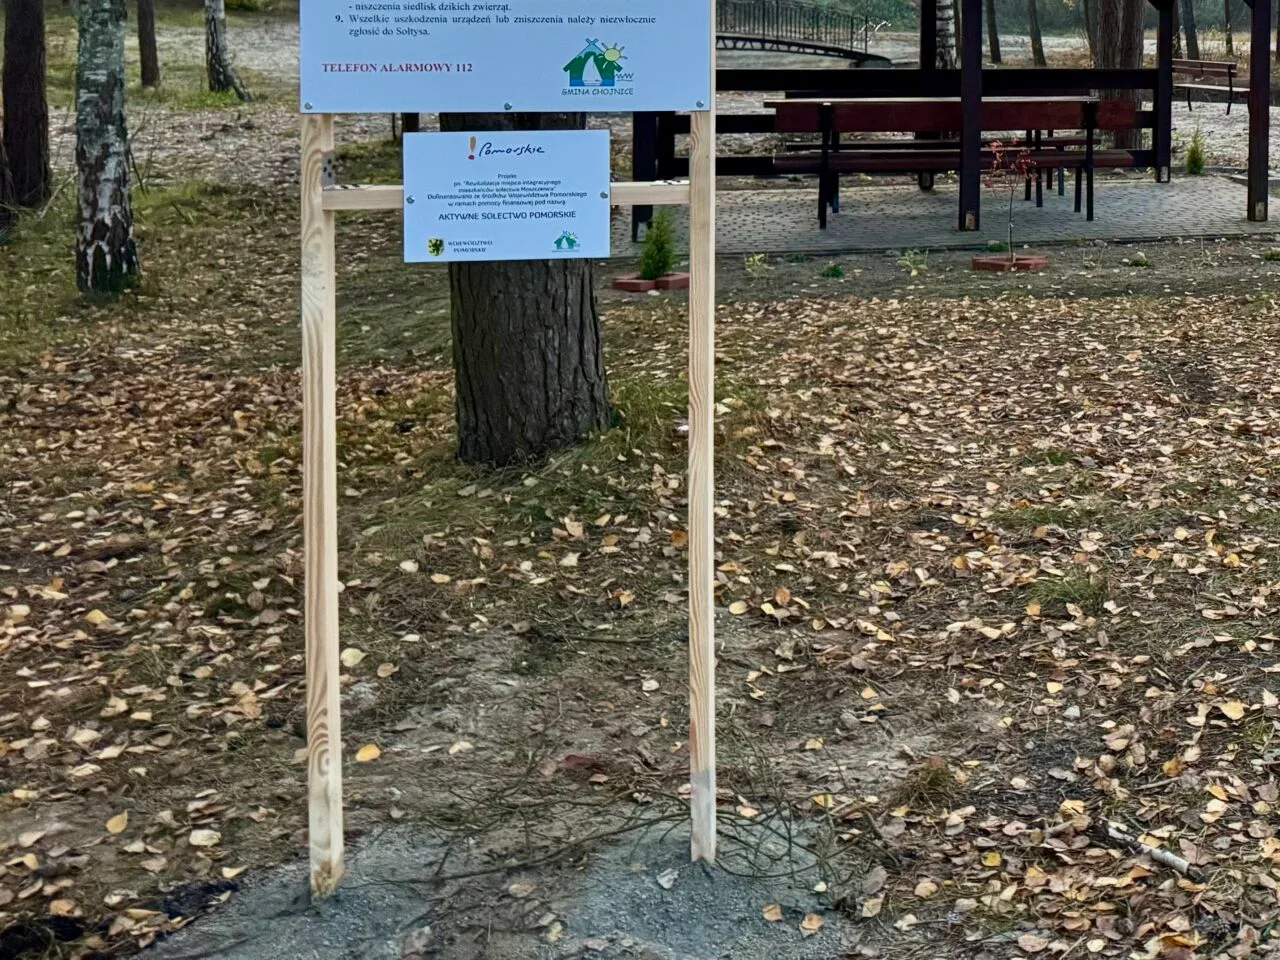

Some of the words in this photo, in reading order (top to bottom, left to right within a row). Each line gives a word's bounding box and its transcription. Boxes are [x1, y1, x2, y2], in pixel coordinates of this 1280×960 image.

[354, 1, 401, 9] niszczenia
[402, 1, 436, 9] siedlisk
[437, 1, 470, 9] dzikich
[472, 2, 512, 11] zwierząt.
[334, 14, 343, 22] 9.
[348, 14, 390, 22] Wszelkie
[394, 14, 447, 22] uszkodzenia
[451, 14, 491, 24] urządzeń
[495, 14, 509, 22] lub
[513, 14, 563, 22] zniszczenia
[567, 14, 595, 24] należy
[599, 15, 656, 23] niezwłocznie
[381, 26, 393, 34] do
[395, 26, 430, 36] Sołtysa.
[321, 63, 377, 73] TELEFON
[380, 63, 453, 73] ALARMOWY
[456, 63, 473, 73] 112
[561, 88, 590, 96] GMINA
[592, 88, 634, 96] CHOJNICE
[479, 142, 545, 158] Pomorskie
[438, 212, 479, 220] AKTYWNE
[529, 210, 577, 219] POMORSKIE
